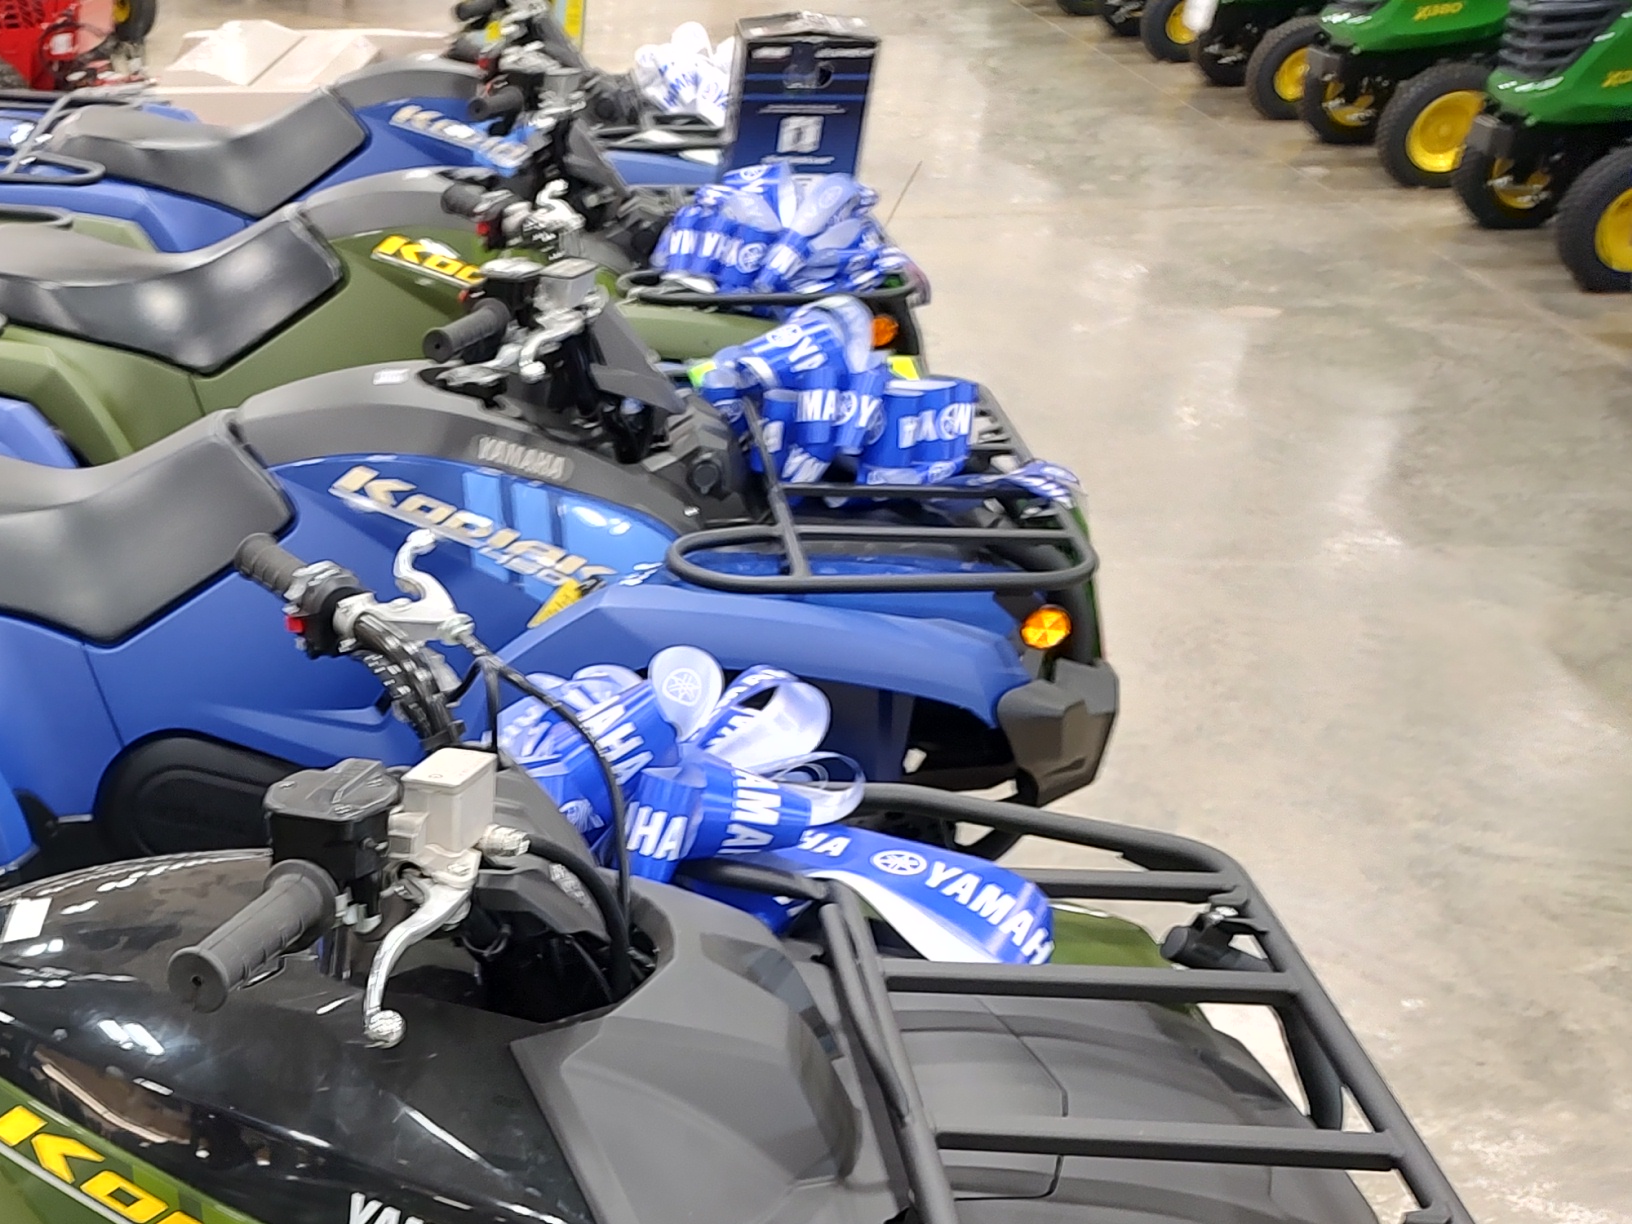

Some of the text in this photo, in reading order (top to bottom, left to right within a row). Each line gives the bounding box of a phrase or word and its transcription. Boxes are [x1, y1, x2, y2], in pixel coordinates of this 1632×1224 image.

[372, 235, 487, 285] KOD
[477, 436, 567, 480] YAMAHA
[925, 861, 1055, 965] YAMAH
